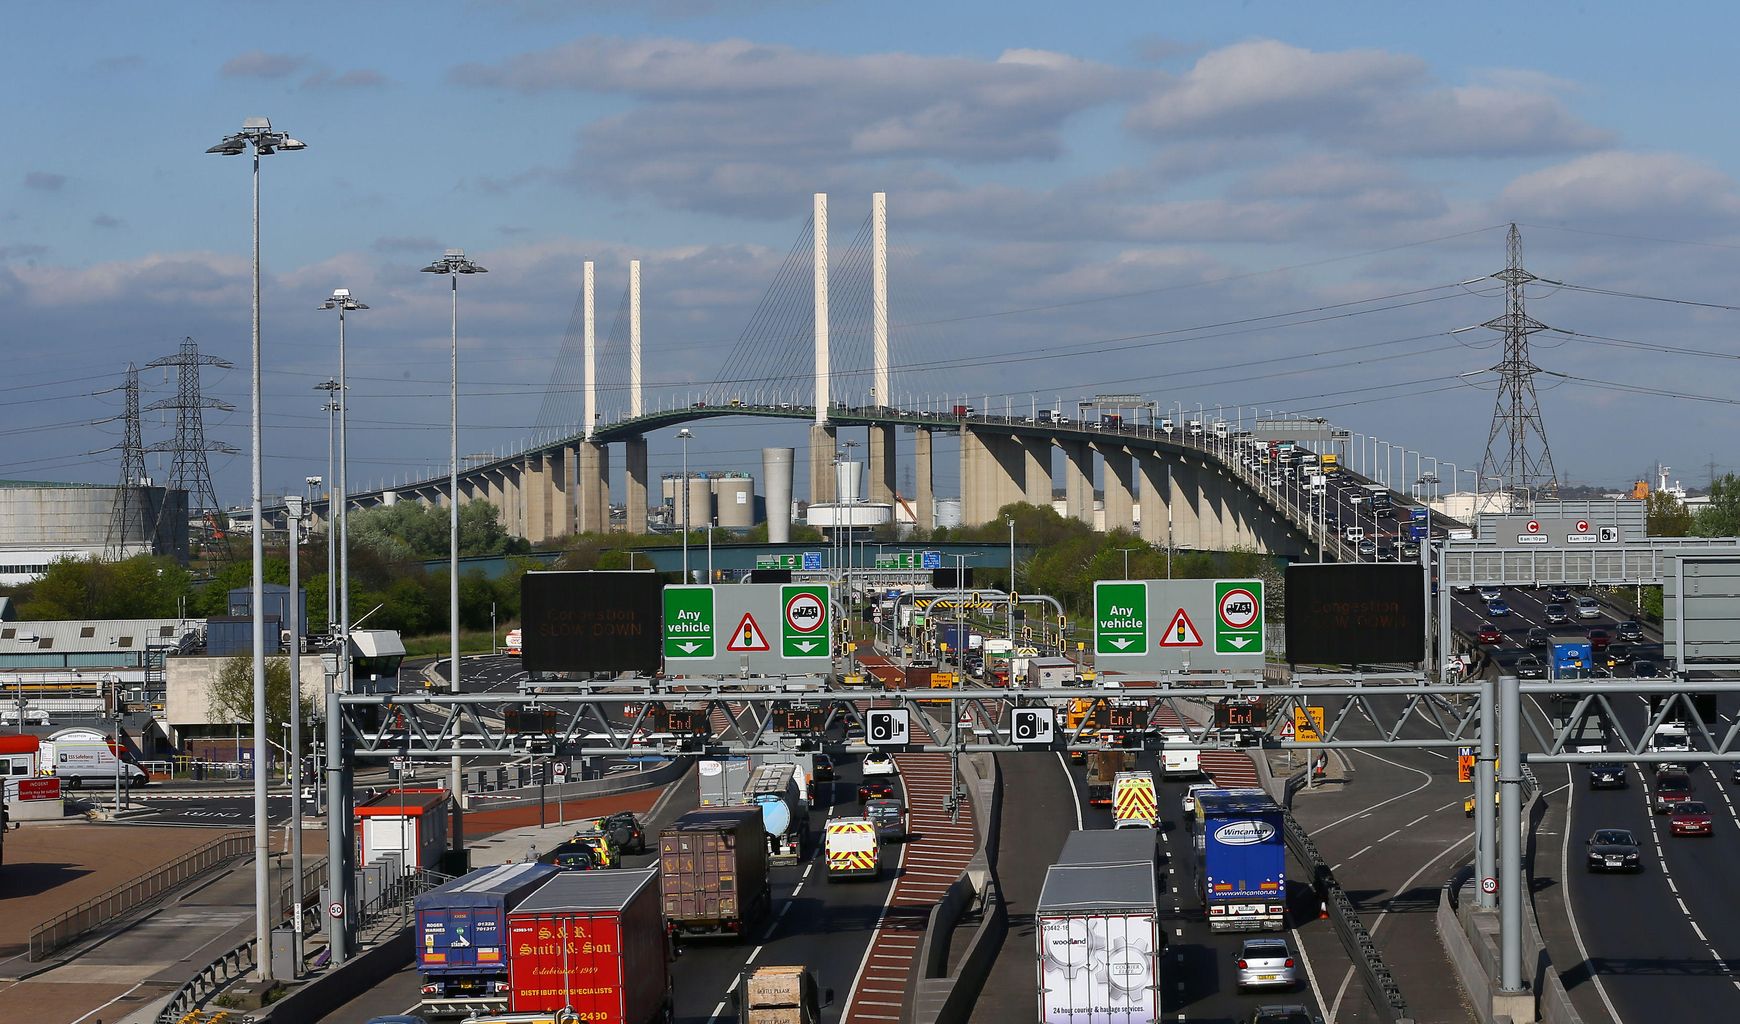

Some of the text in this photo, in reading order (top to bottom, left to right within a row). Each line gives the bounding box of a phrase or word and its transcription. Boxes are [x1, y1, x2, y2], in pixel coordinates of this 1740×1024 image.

[677, 610, 701, 621] Any
[1110, 605, 1133, 617] Any
[592, 624, 642, 636] DOWN
[668, 622, 710, 632] vehicle
[1100, 618, 1143, 628] vehicle
[669, 713, 691, 730] End
[787, 712, 810, 729] End
[1110, 709, 1132, 726] End
[1229, 708, 1251, 724] End
[538, 926, 591, 940] S. & R.
[520, 942, 612, 956] Smith & Son
